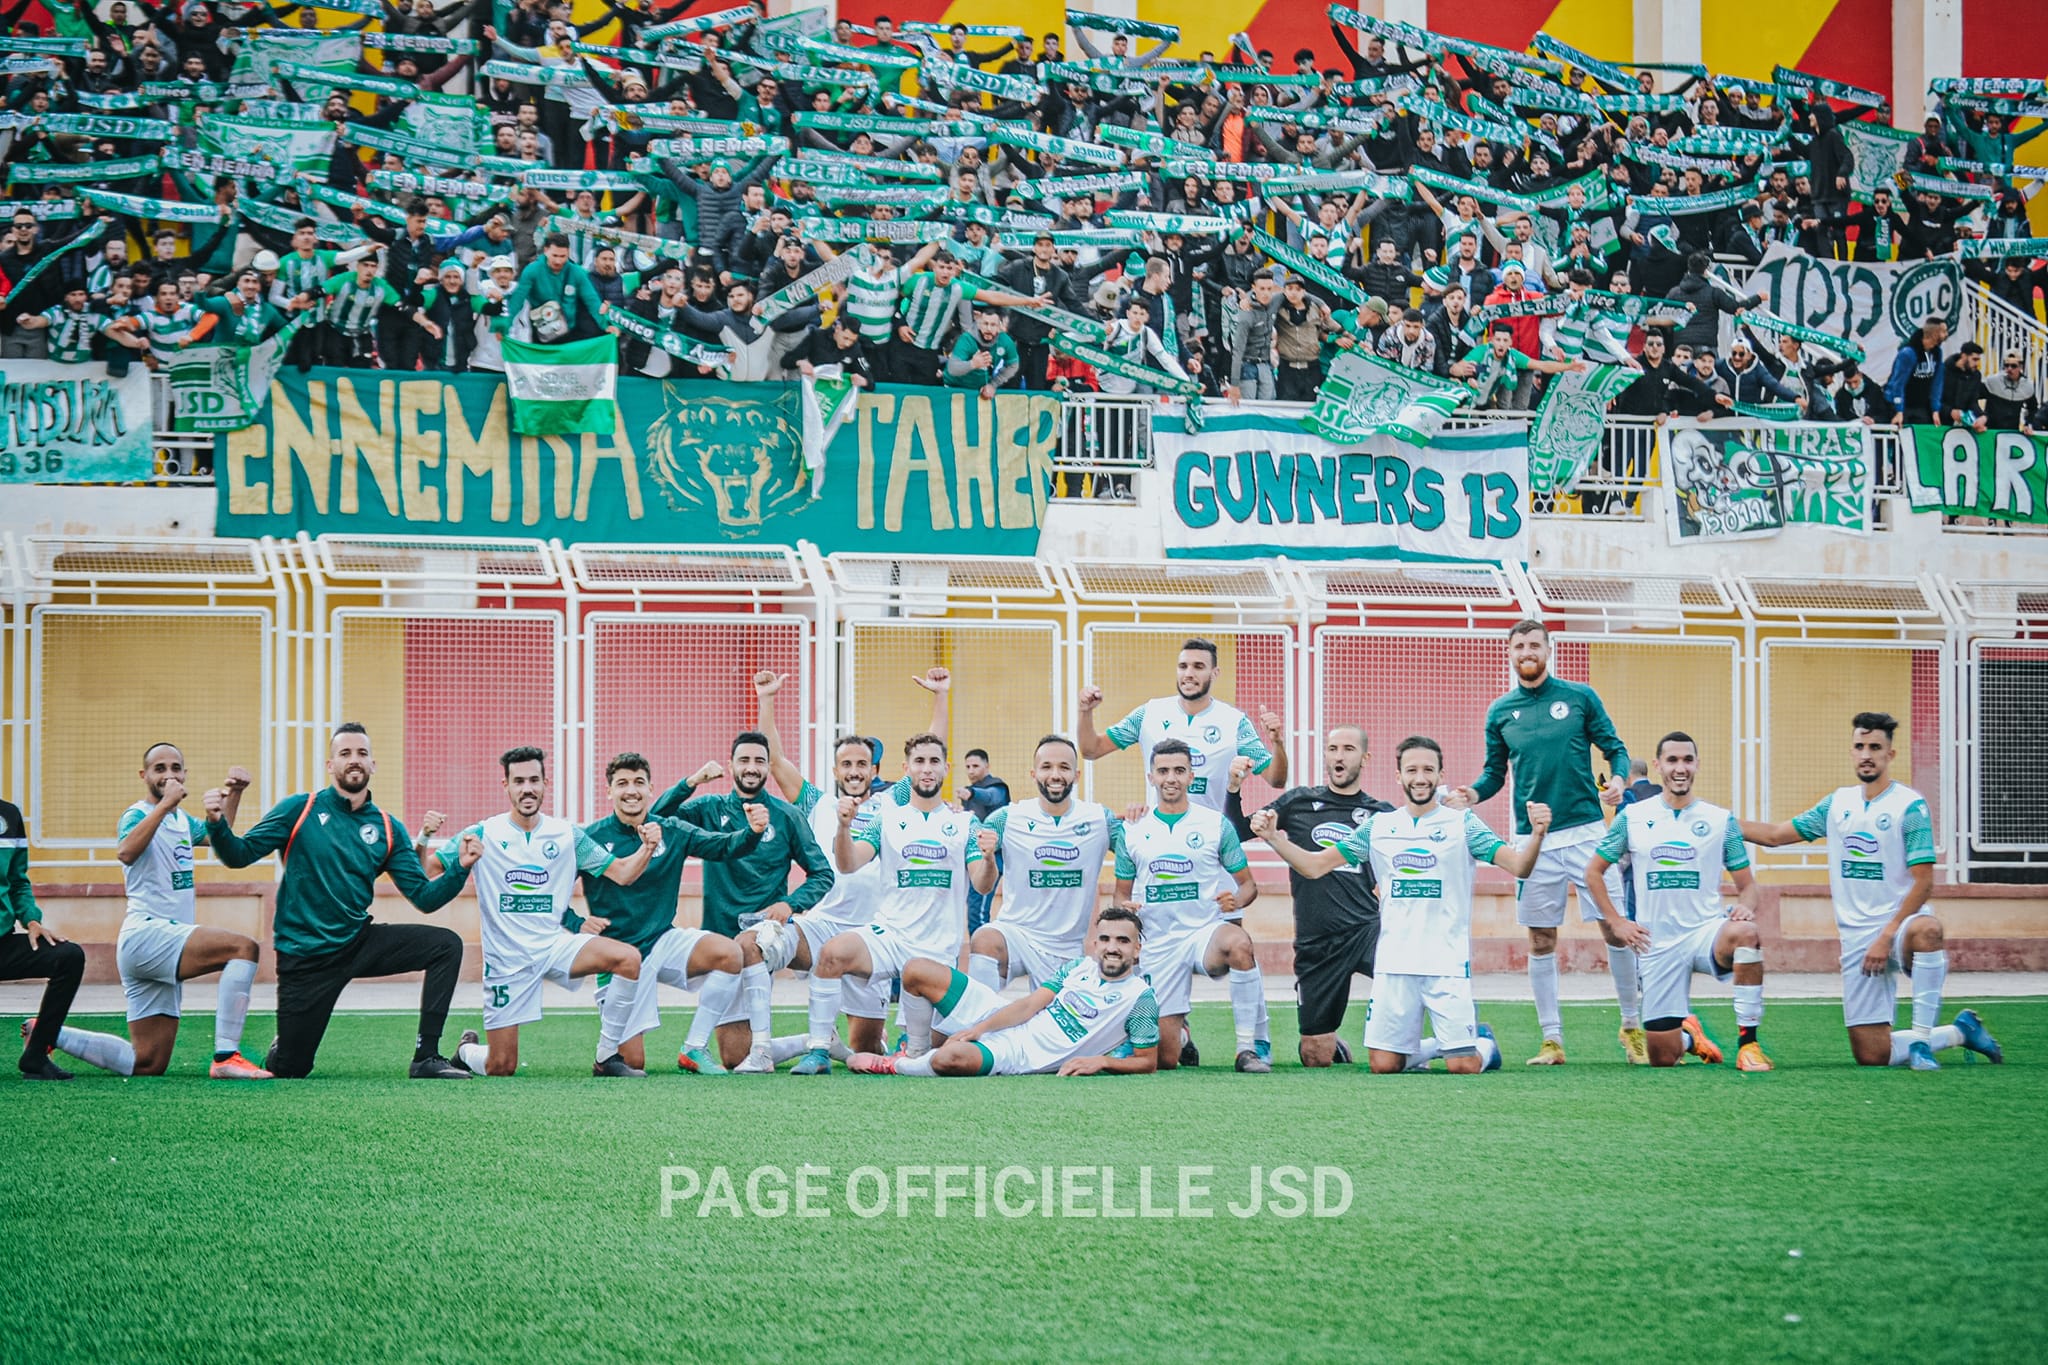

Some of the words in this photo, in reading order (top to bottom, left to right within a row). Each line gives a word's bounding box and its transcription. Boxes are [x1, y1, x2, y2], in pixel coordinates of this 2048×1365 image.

[960, 70, 999, 89] JSD
[79, 117, 135, 134] JSD
[839, 221, 861, 239] MA
[609, 309, 656, 338] Unico
[842, 393, 1062, 532] TAHER
[1902, 426, 2048, 517] LAR
[1174, 450, 1446, 531] GUNNERS
[1462, 472, 1522, 540] 13
[492, 985, 510, 1008] 15
